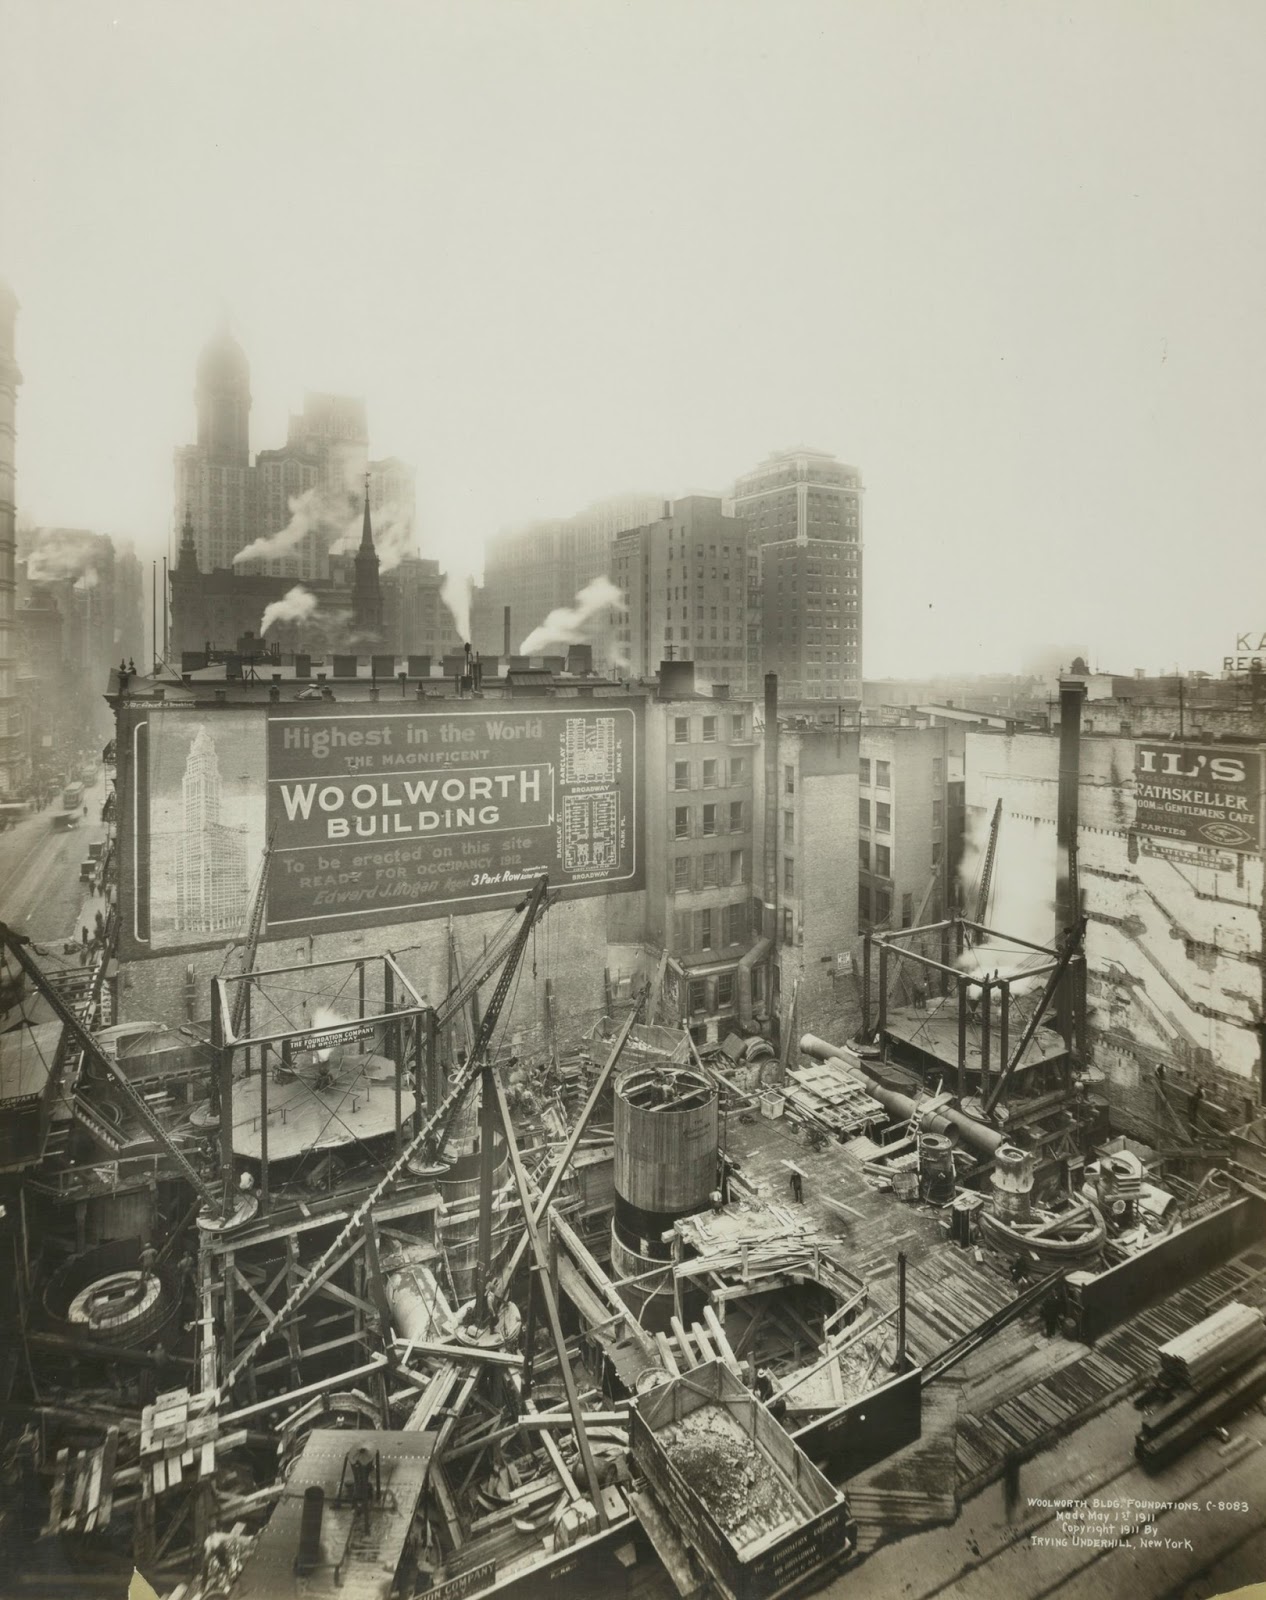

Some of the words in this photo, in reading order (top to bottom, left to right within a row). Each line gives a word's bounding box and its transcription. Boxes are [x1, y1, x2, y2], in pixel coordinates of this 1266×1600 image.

[283, 726, 392, 758] Highest
[407, 723, 428, 744] in
[440, 722, 476, 742] the
[486, 718, 543, 740] World
[344, 756, 374, 768] THE
[382, 750, 490, 766] MAGNIFICENT
[280, 769, 540, 821] WOOLWORTH
[571, 784, 610, 794] BROADWAY
[1134, 782, 1249, 811] RATHSKELLER
[327, 805, 500, 838] BUILDING
[1164, 802, 1226, 820] GENTLEMENS
[1140, 823, 1187, 836] PARTIES
[283, 859, 305, 874] To
[318, 856, 341, 870] be
[353, 846, 422, 866] erected
[432, 847, 452, 858] on
[462, 840, 491, 856] this
[502, 836, 533, 851] site
[300, 871, 362, 888] READY
[376, 867, 407, 880] FOR
[417, 857, 494, 875] OCCUPANCY
[500, 854, 522, 866] 1912
[572, 871, 609, 880] BROADWAY
[313, 886, 378, 906] Edward
[471, 874, 480, 886] 3
[480, 872, 502, 886] Park
[304, 1033, 343, 1046] FOUNDATION
[344, 1027, 374, 1039] COMPANY
[318, 1036, 357, 1047] BROADWAY
[444, 1563, 495, 1594] COMPANY
